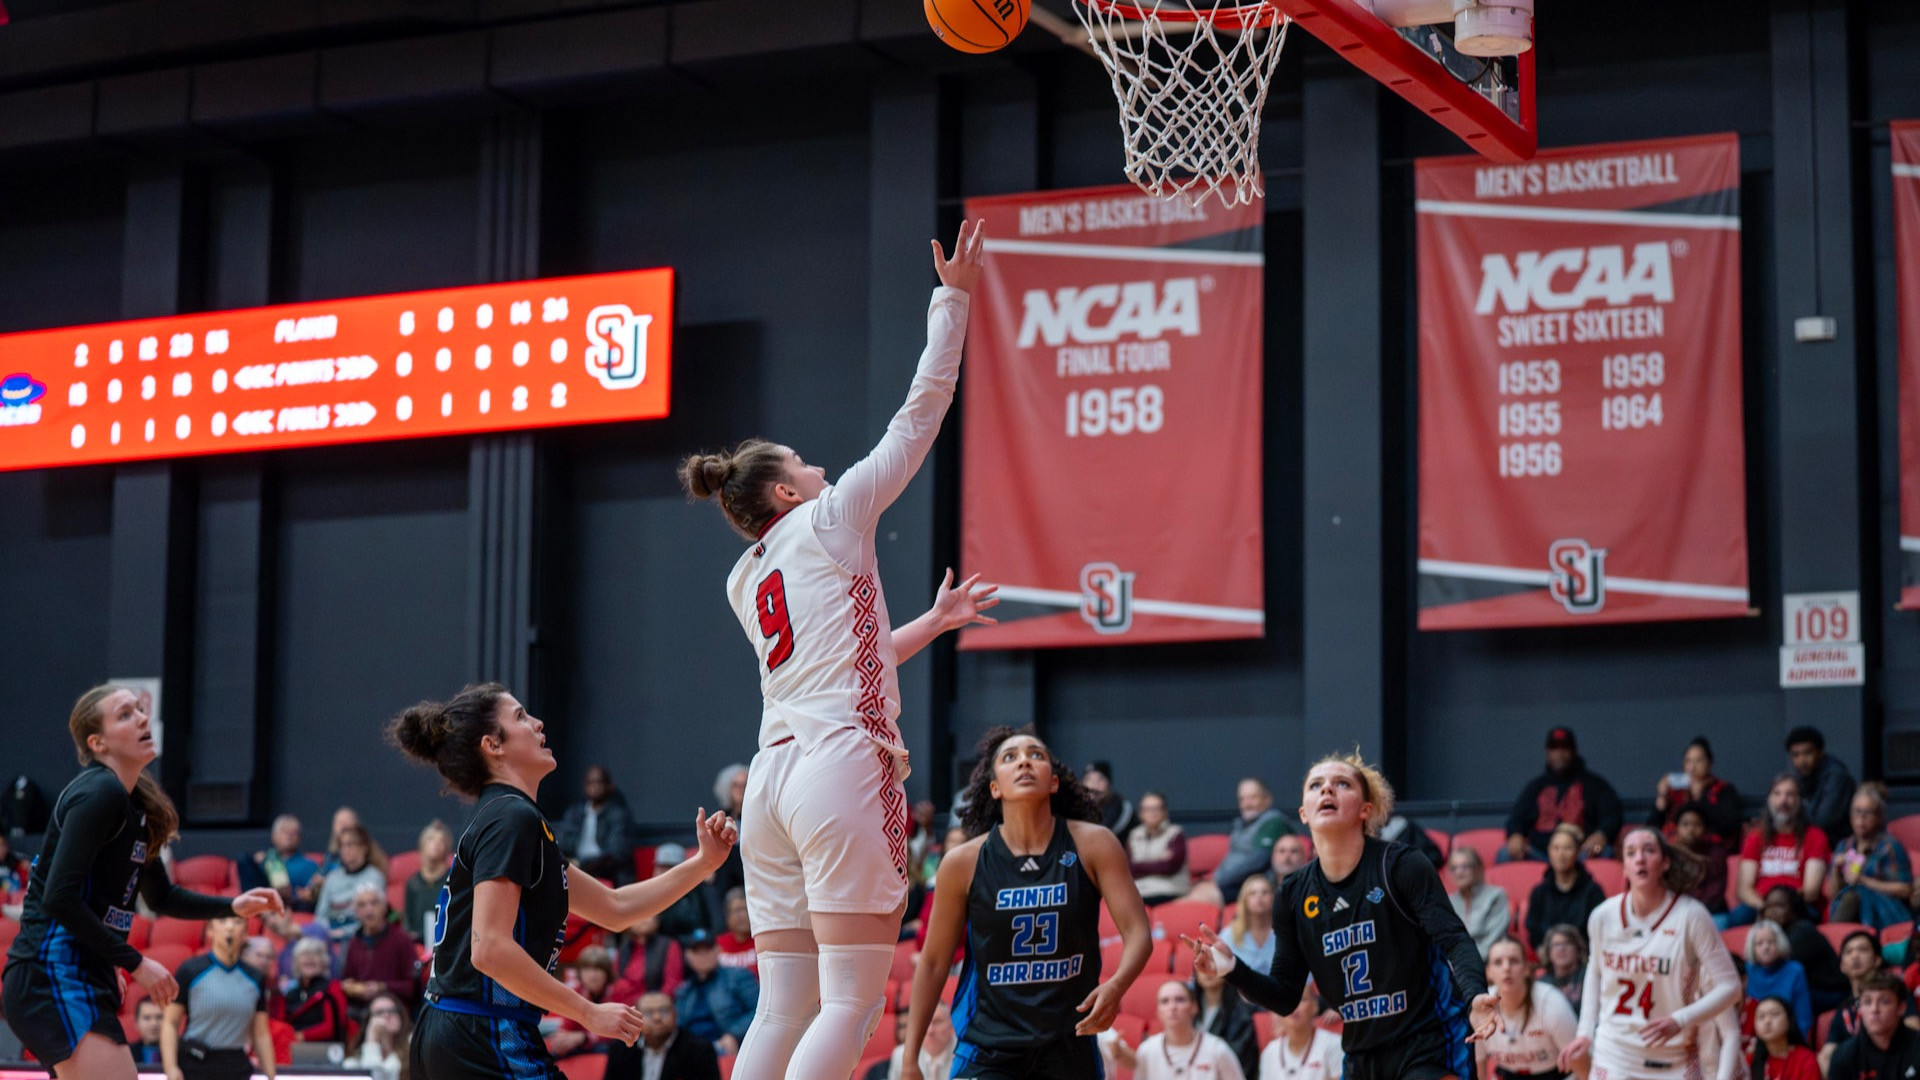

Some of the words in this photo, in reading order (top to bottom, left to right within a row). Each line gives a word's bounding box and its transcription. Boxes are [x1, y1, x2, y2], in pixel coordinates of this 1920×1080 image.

[1475, 162, 1544, 198] MEN'S
[1546, 152, 1679, 194] BASKETBALL
[1020, 202, 1083, 236] MEN'S
[1085, 193, 1208, 231] BASKETBALL
[1475, 241, 1674, 315] NCAA
[1017, 277, 1200, 348] NCAA
[1498, 312, 1568, 347] SWEET
[1573, 306, 1664, 342] SIXTEEN
[1057, 345, 1114, 377] FINAL
[1116, 339, 1171, 373] FOUR
[1499, 358, 1561, 395] 1953
[1602, 351, 1665, 389] 1958
[1066, 384, 1164, 438] 1958
[1499, 400, 1561, 437] 1955
[1602, 392, 1663, 430] 1964
[1499, 440, 1562, 478] 1956
[756, 569, 794, 674] 9
[1795, 606, 1848, 642] 109
[995, 882, 1068, 911] SANTA
[1303, 895, 1319, 919] C
[1011, 911, 1059, 956] 23
[987, 953, 1084, 986] BARBARA
[1613, 977, 1655, 1020] 24
